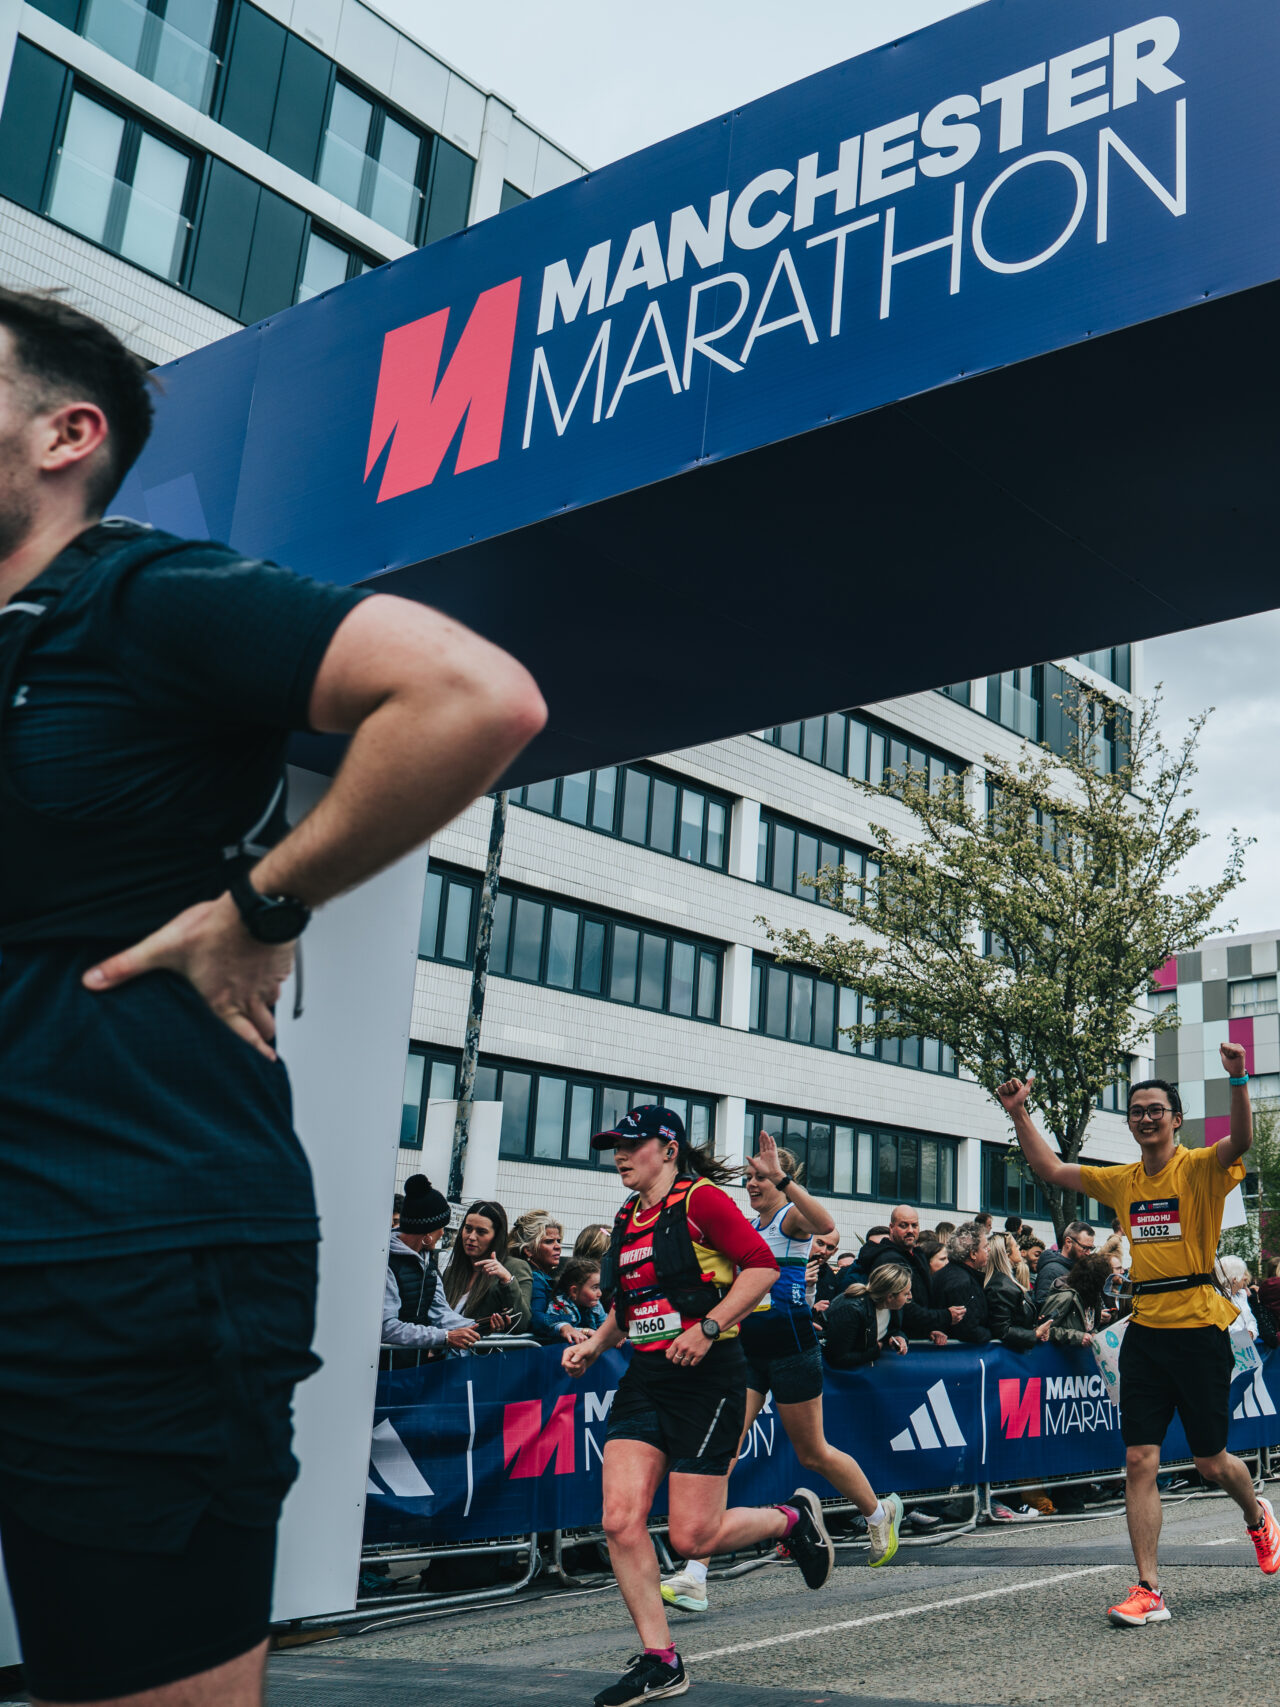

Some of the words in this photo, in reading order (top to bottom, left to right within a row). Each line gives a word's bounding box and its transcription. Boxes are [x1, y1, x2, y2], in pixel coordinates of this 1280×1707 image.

[537, 15, 1185, 335] MANCHESTER
[522, 98, 1187, 450] MARATHON
[1160, 1214, 1171, 1222] HU
[1140, 1225, 1169, 1237] 16032
[634, 1304, 659, 1316] SARAH
